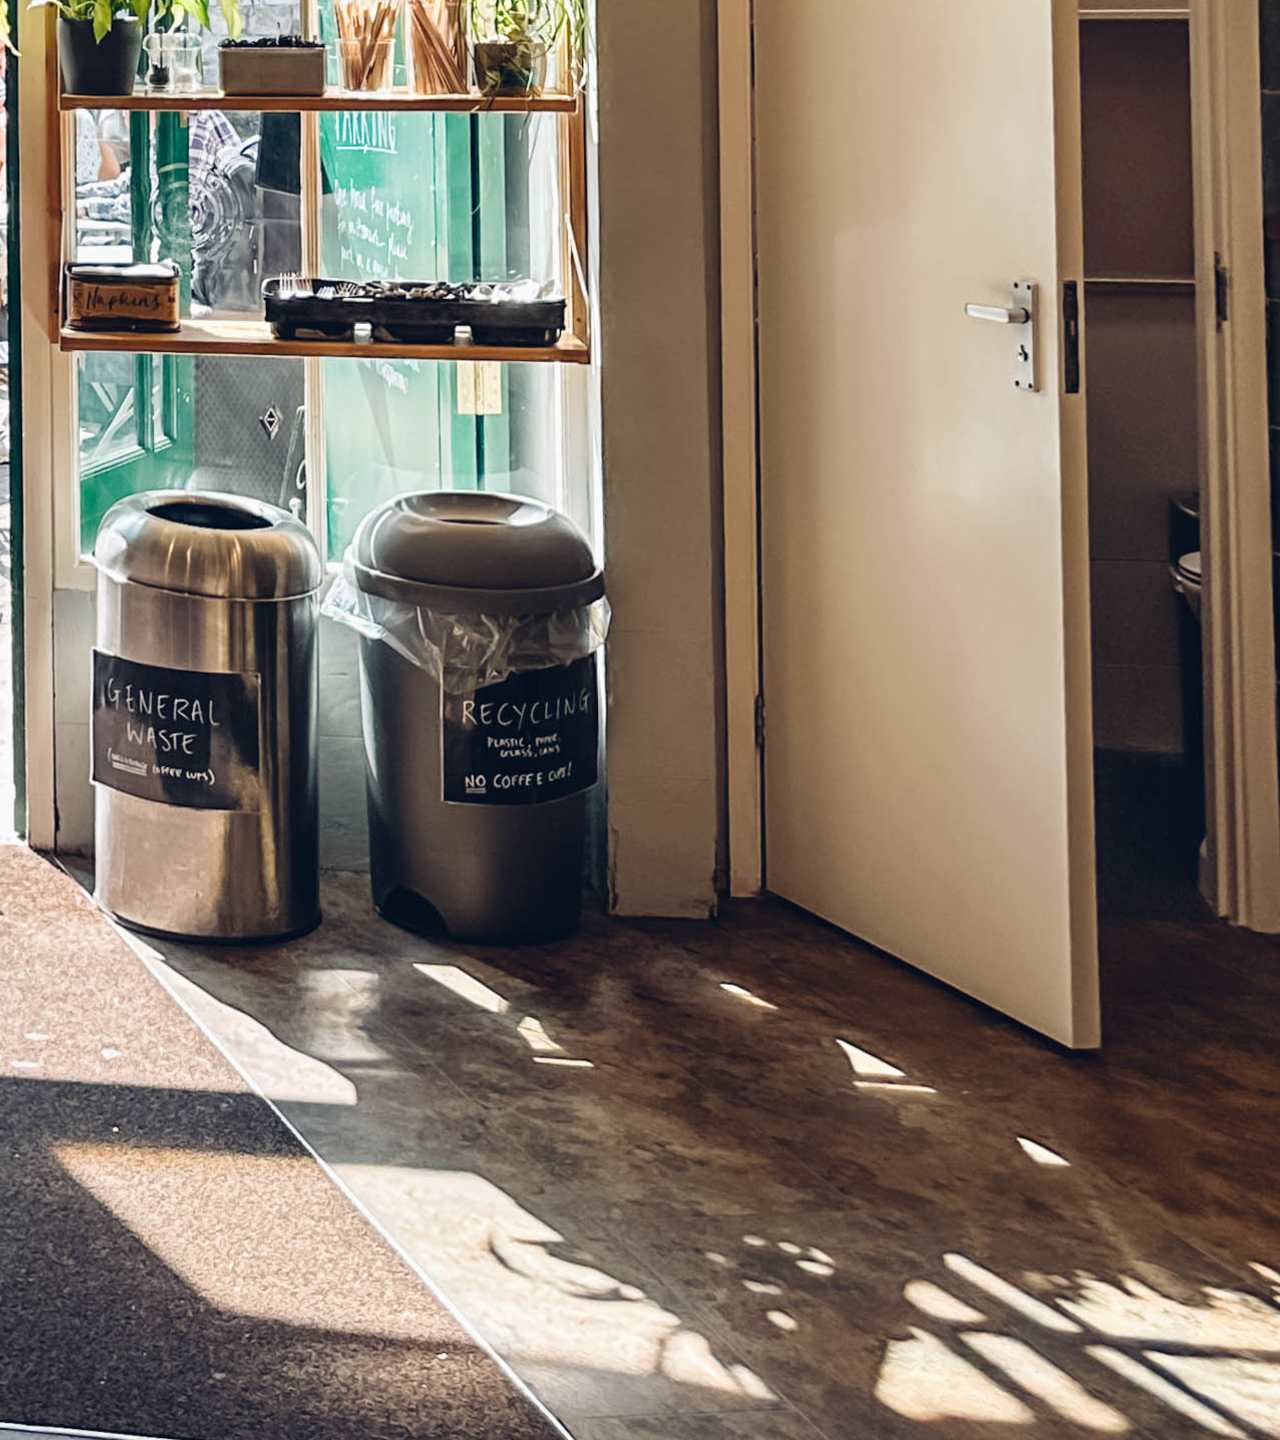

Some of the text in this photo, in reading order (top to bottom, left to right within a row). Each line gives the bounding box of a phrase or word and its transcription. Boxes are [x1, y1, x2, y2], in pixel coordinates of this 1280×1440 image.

[108, 678, 220, 726] GENERAL
[462, 688, 590, 730] RECYCLING
[127, 721, 198, 754] WASTE
[464, 774, 487, 789] NO
[493, 772, 543, 789] COFFEE
